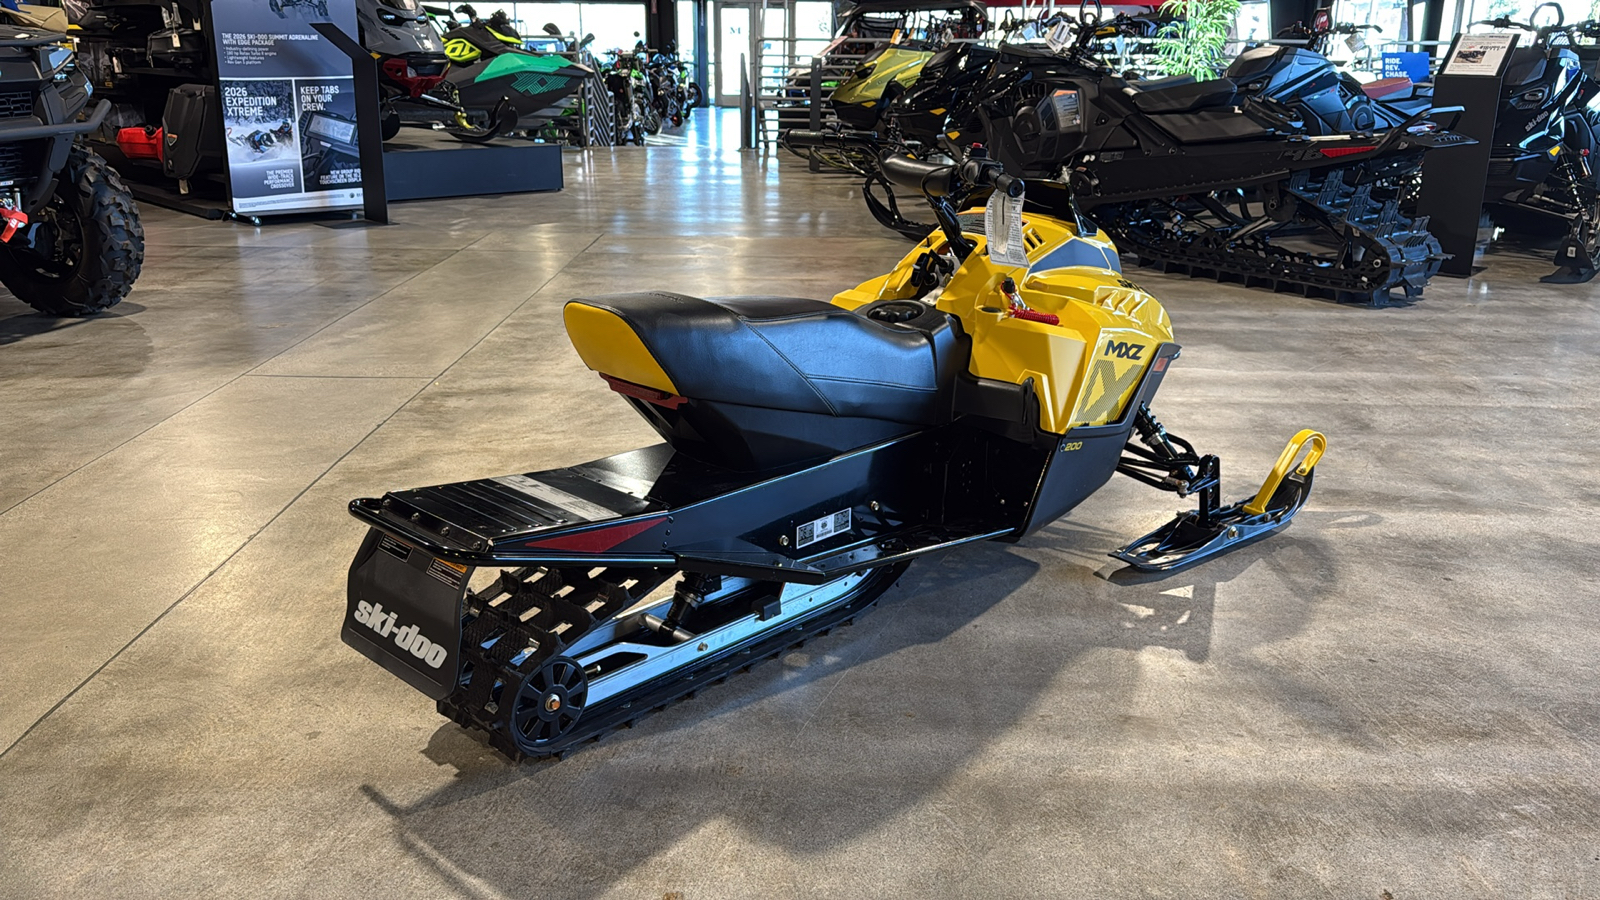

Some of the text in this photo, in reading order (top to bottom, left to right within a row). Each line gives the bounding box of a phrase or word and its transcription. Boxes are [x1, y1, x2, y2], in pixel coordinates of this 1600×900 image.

[225, 87, 248, 96] 2026
[226, 96, 277, 106] EXPEDITION
[227, 107, 263, 116] XTREME
[302, 103, 326, 111] CREW.
[1525, 110, 1549, 132] ski-doo
[1104, 340, 1146, 360] MXZ
[1065, 442, 1083, 451] 200
[354, 600, 447, 669] ski-doo
